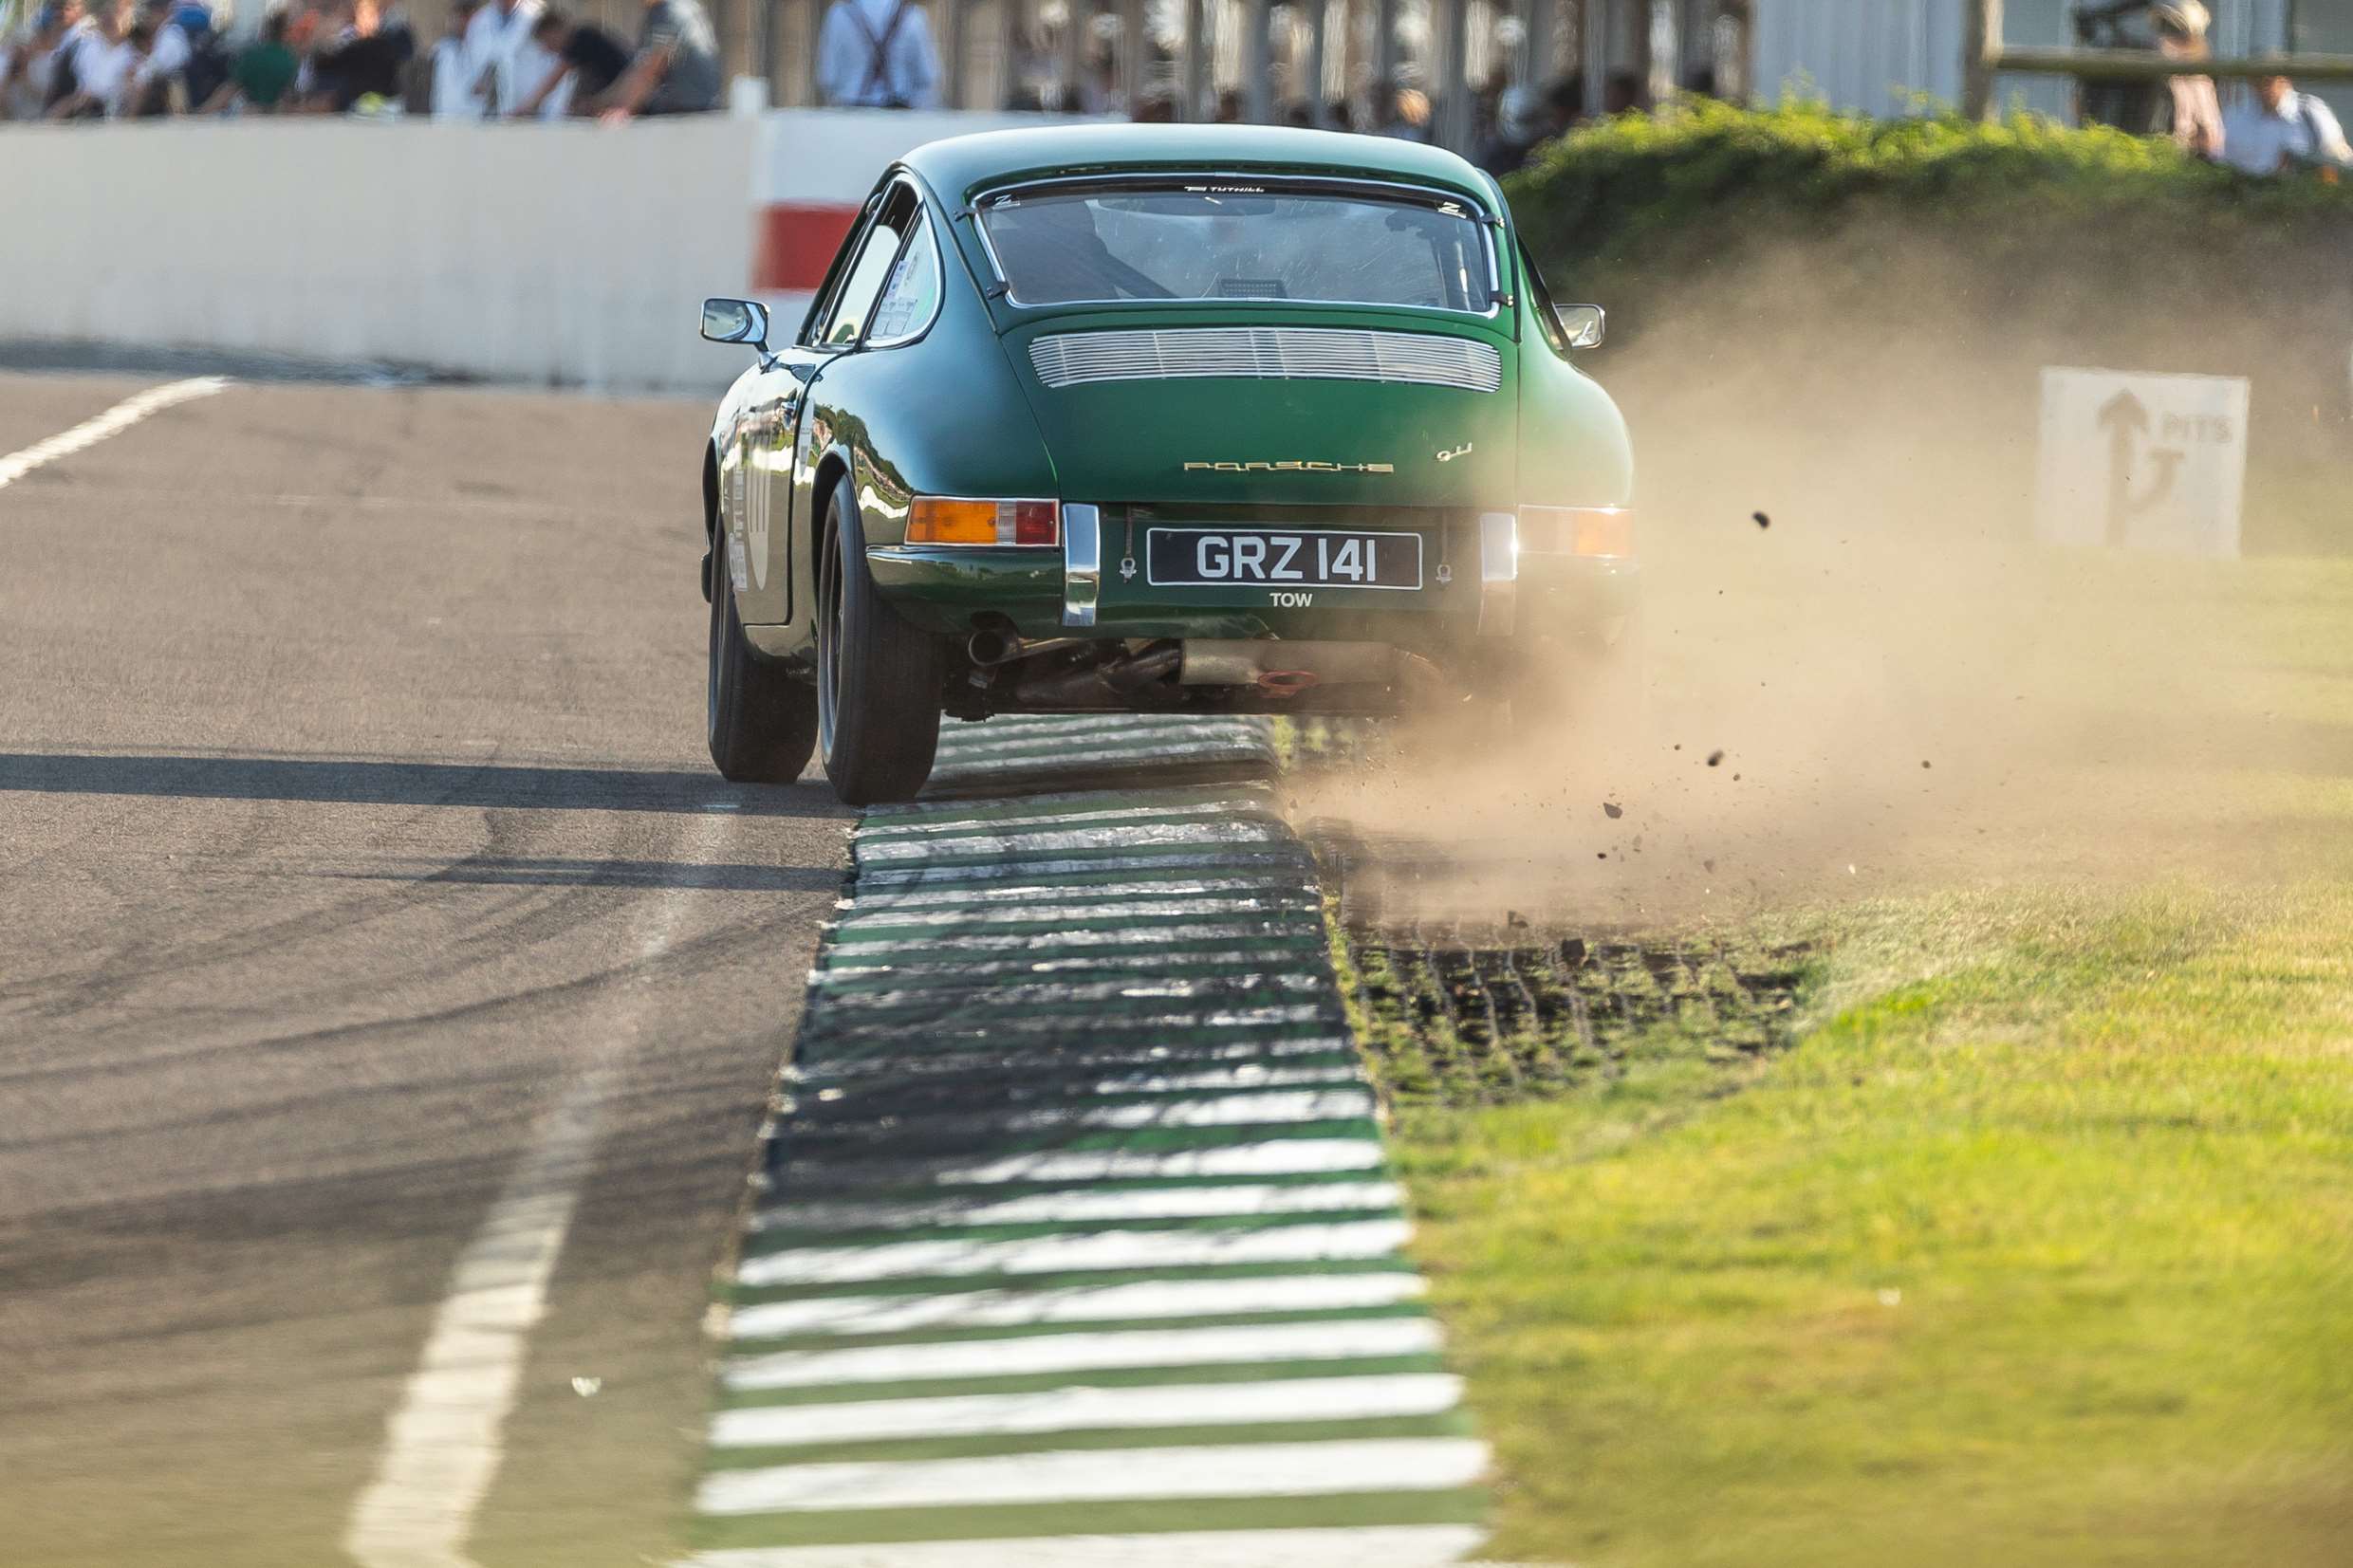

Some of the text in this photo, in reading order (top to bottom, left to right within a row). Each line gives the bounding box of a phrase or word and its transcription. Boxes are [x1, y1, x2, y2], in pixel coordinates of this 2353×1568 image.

[2162, 413, 2233, 443] PITS
[1184, 461, 1395, 472] PORSCHE
[1196, 535, 1377, 581] GRZ 141
[1269, 592, 1313, 607] TOW
